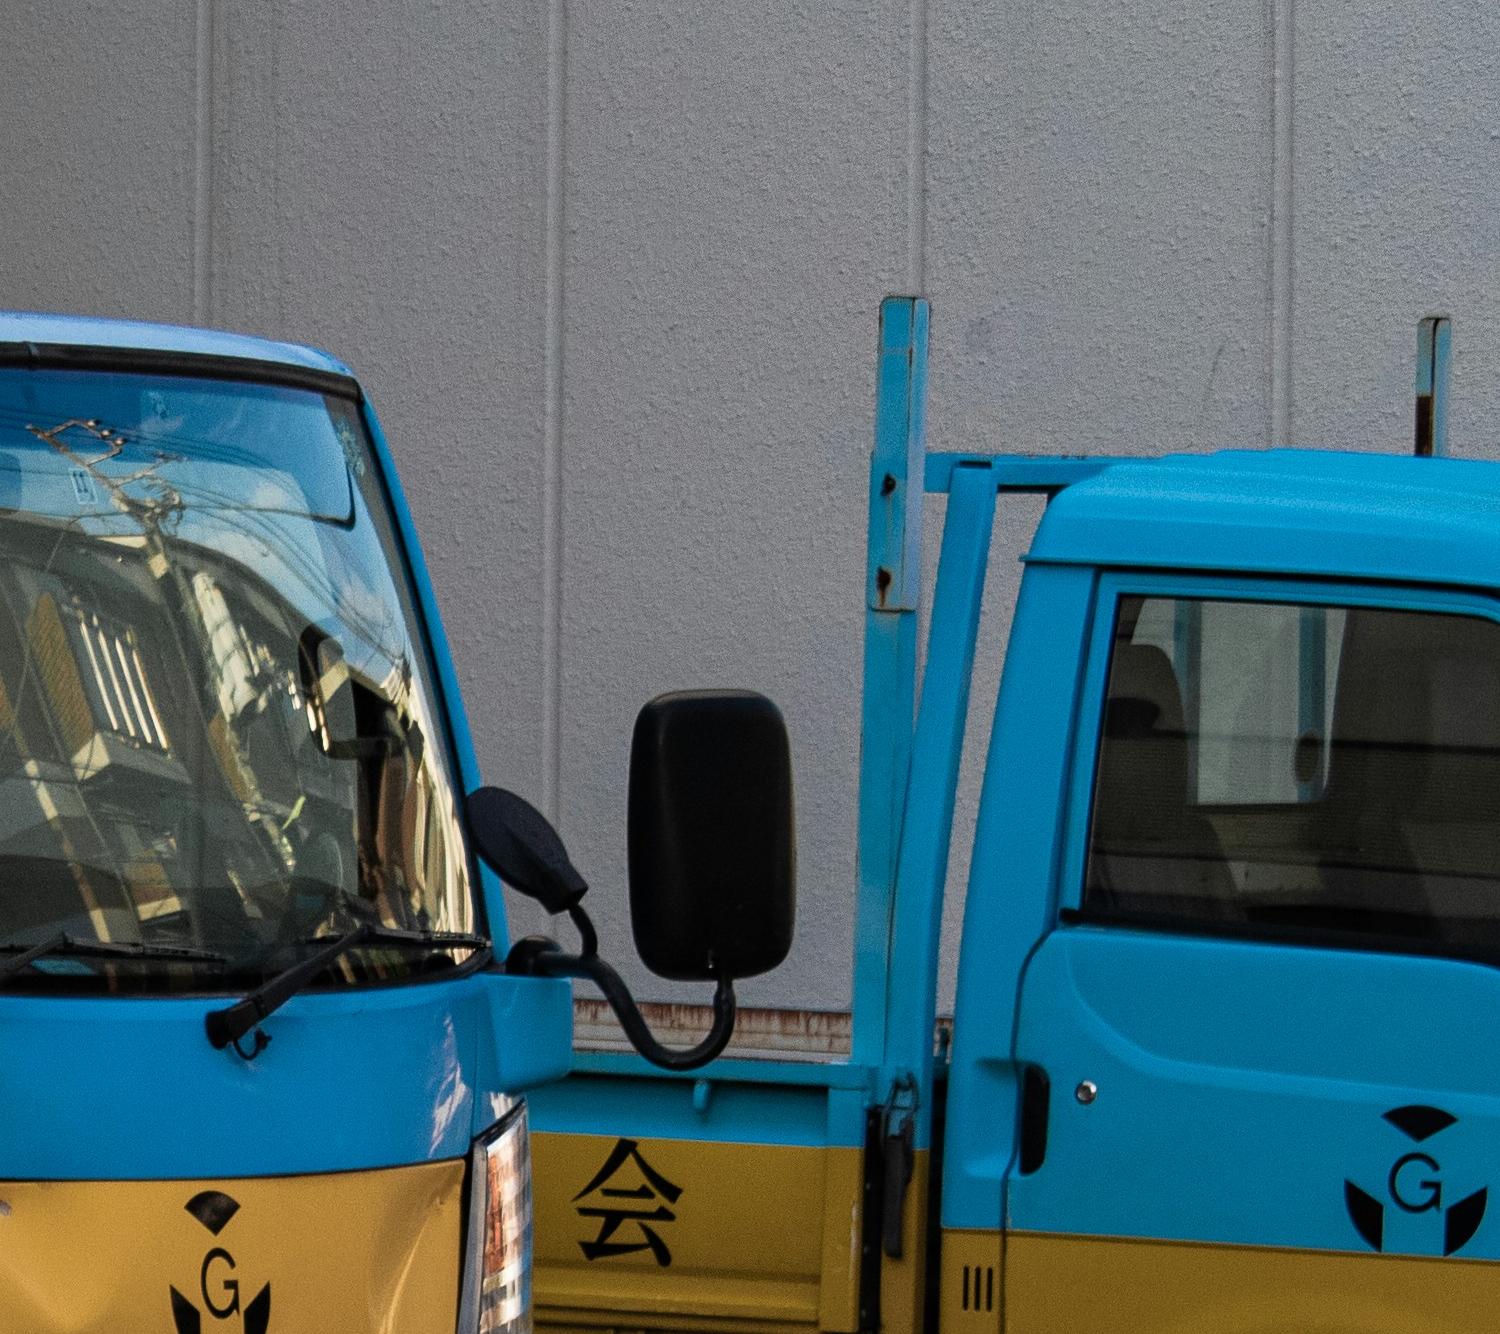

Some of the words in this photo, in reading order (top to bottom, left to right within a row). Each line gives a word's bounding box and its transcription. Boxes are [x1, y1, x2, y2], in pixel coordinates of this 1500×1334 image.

[572, 1138, 683, 1266] 会
[1388, 1152, 1442, 1214] G
[201, 1247, 241, 1320] G
